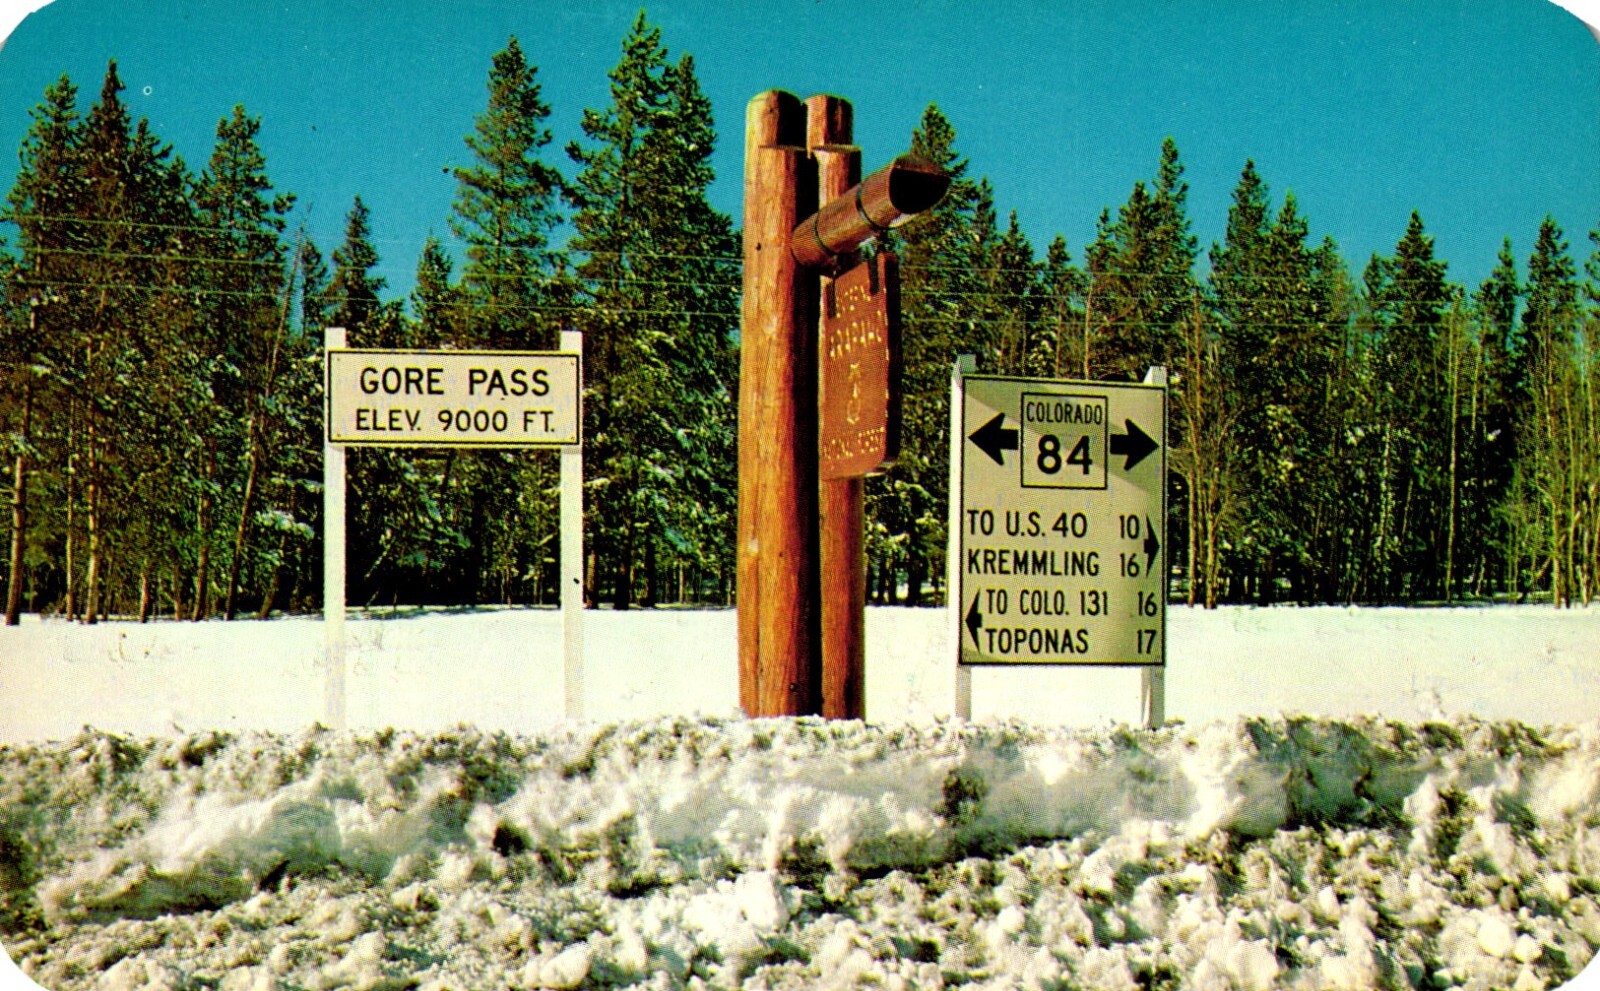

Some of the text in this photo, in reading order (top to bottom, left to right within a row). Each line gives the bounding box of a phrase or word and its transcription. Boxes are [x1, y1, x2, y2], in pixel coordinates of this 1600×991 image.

[360, 367, 549, 396] GORE PASS
[356, 409, 555, 432] ELEV. 9000 FT.
[1026, 401, 1103, 425] COLORADO
[1037, 434, 1093, 475] 84
[967, 510, 1140, 539] TO U.S. 40 10
[968, 549, 1140, 577] KREMMLING 16
[986, 589, 1158, 617] TO COLO. 131 16
[985, 628, 1157, 654] TOPONAS 17
